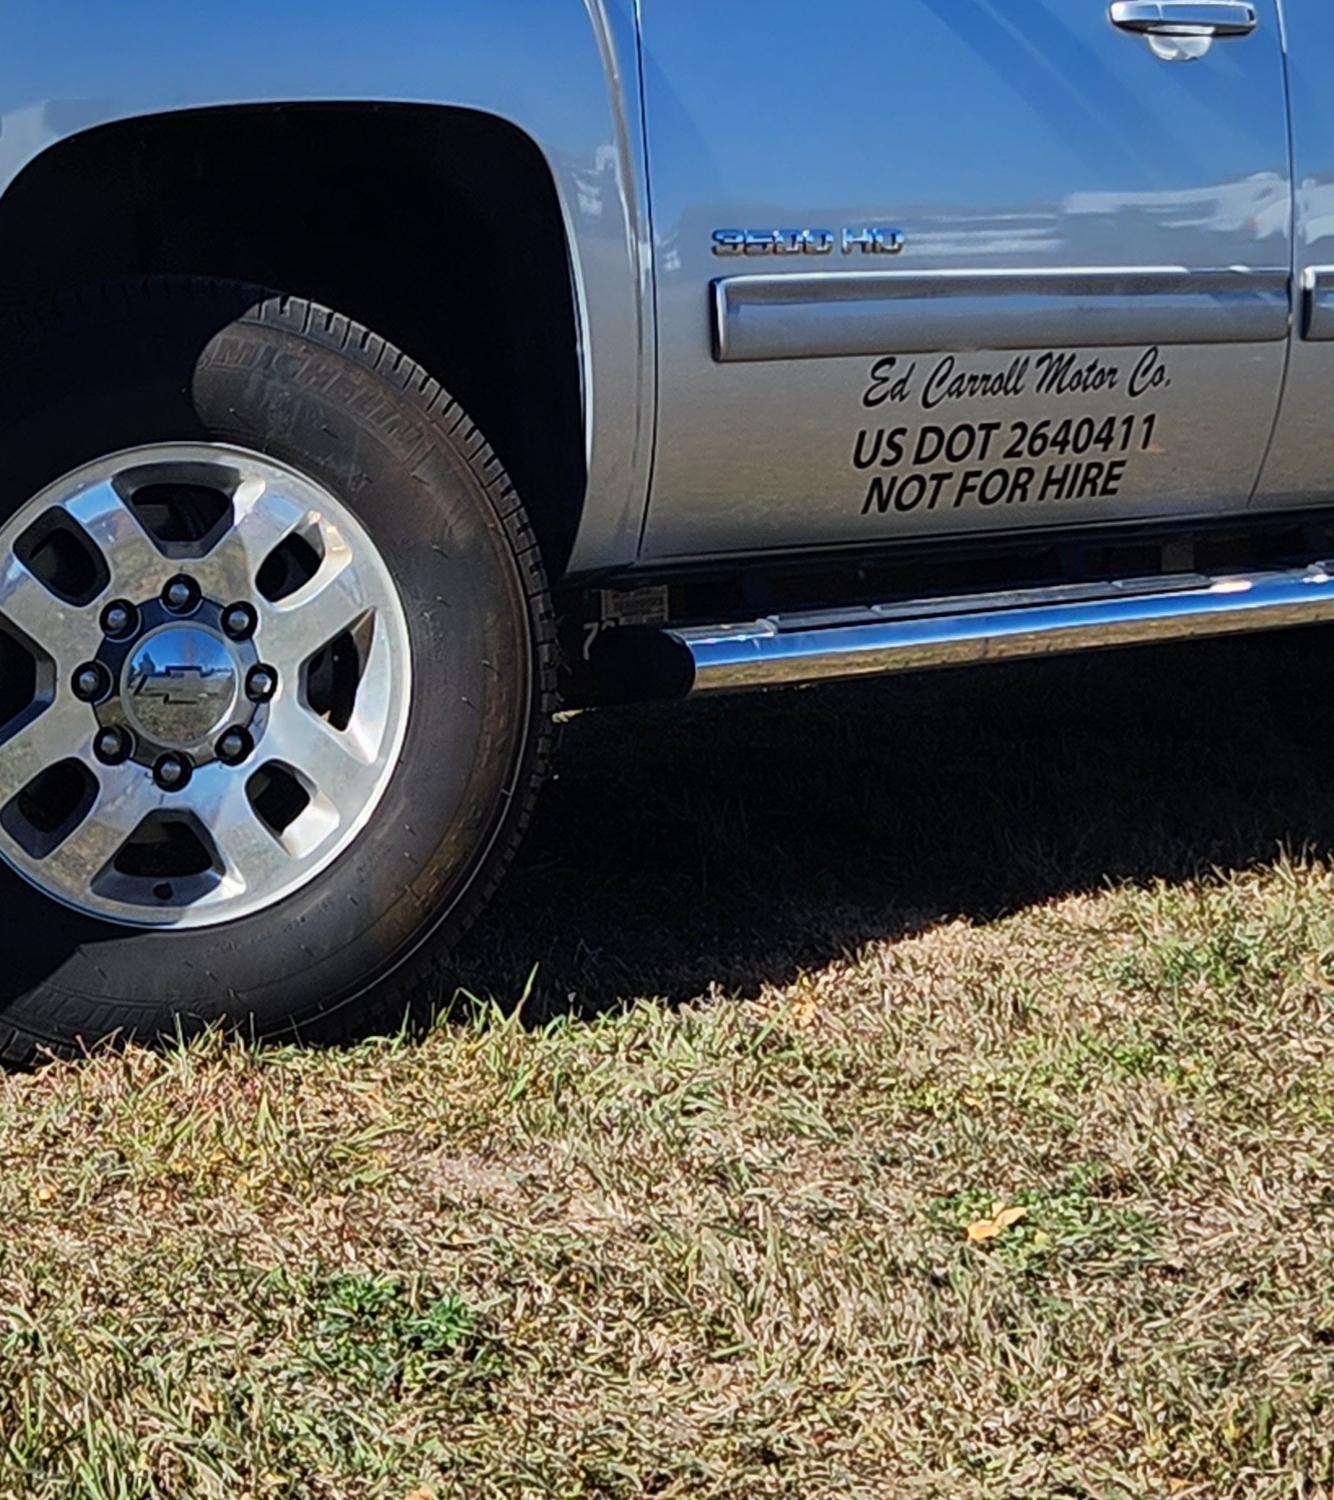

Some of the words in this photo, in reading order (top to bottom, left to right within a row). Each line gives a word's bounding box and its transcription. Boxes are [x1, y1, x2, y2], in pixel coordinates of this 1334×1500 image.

[711, 228, 834, 256] 3500
[841, 227, 905, 256] HD
[862, 357, 913, 408] Ed
[921, 355, 1028, 409] Carroll
[1034, 352, 1120, 397] Motor
[1128, 346, 1172, 398] Co.
[853, 427, 907, 469] US
[912, 422, 1002, 466] DOT
[1004, 413, 1157, 458] 2640411
[861, 472, 953, 515] NOT
[953, 466, 1033, 508] FOR
[1038, 460, 1128, 501] HIRE
